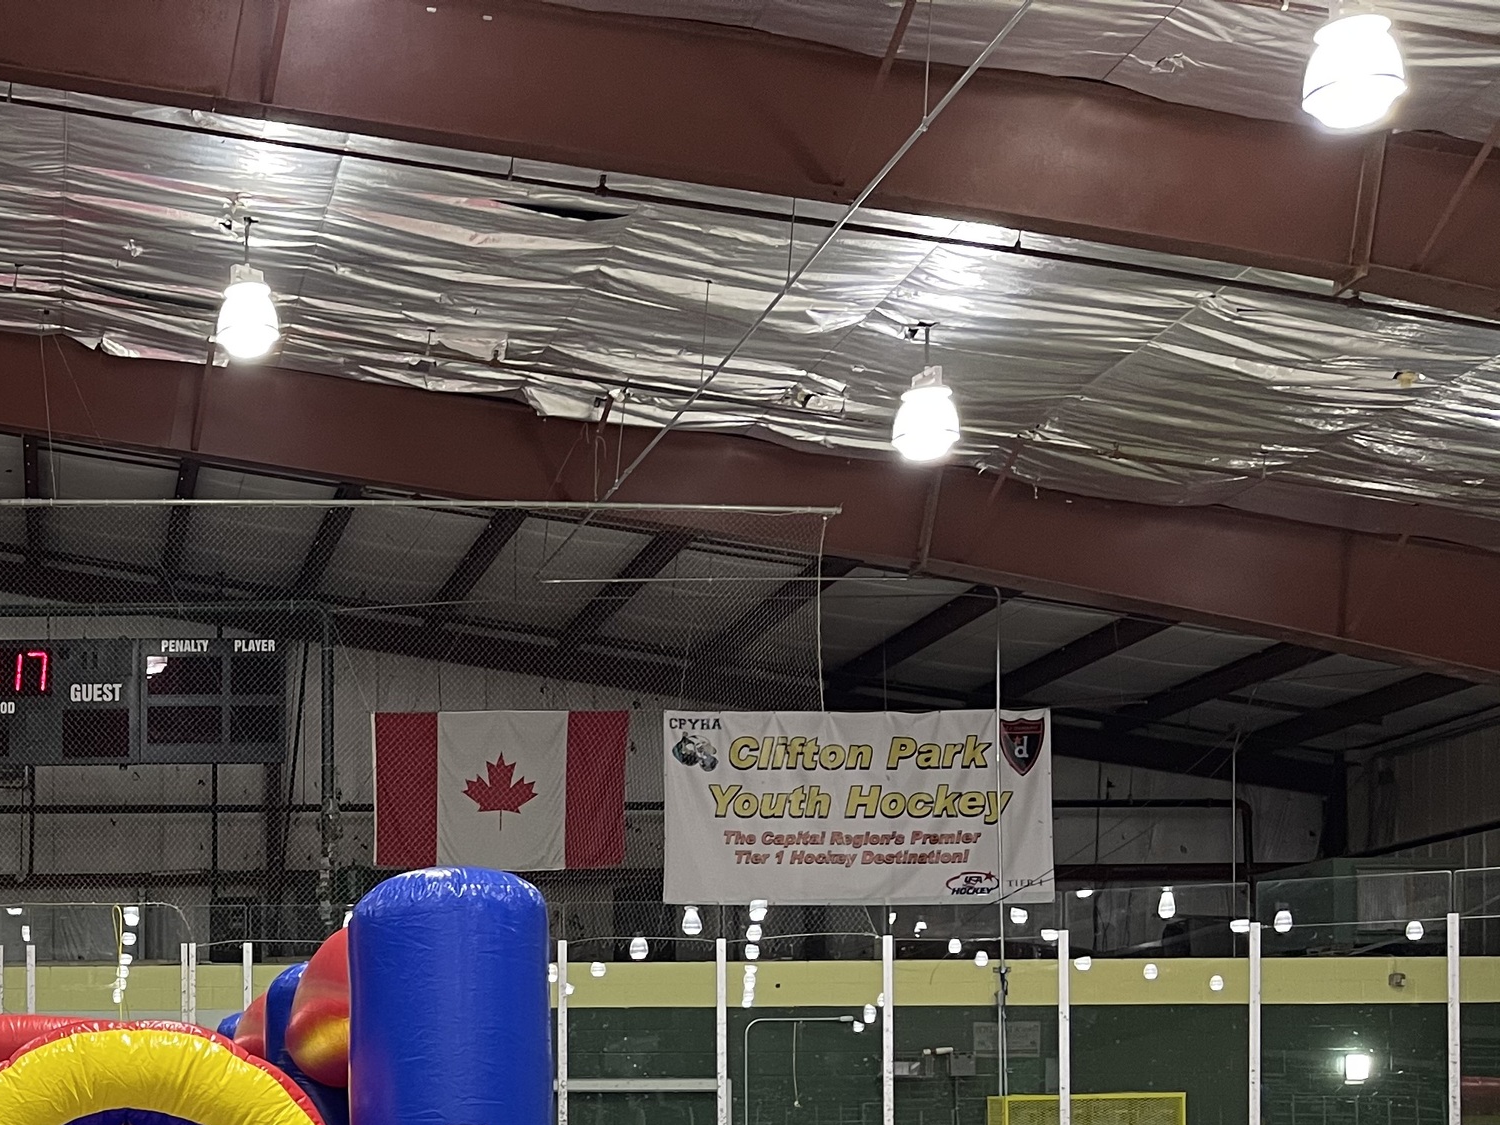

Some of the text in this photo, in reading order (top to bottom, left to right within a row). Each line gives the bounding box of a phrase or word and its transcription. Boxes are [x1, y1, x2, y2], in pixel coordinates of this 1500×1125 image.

[161, 639, 276, 652] PENALTY PLAYER
[69, 683, 122, 702] GUEST
[669, 718, 722, 730] CPYHA
[728, 734, 993, 771] Clifton Park
[708, 783, 1014, 825] Youth Hockey
[723, 829, 981, 848] The Capital Region's Premier
[734, 849, 970, 868] Tier 1 Hockey Destination!
[964, 876, 982, 884] USA
[951, 887, 993, 896] HOCKEY
